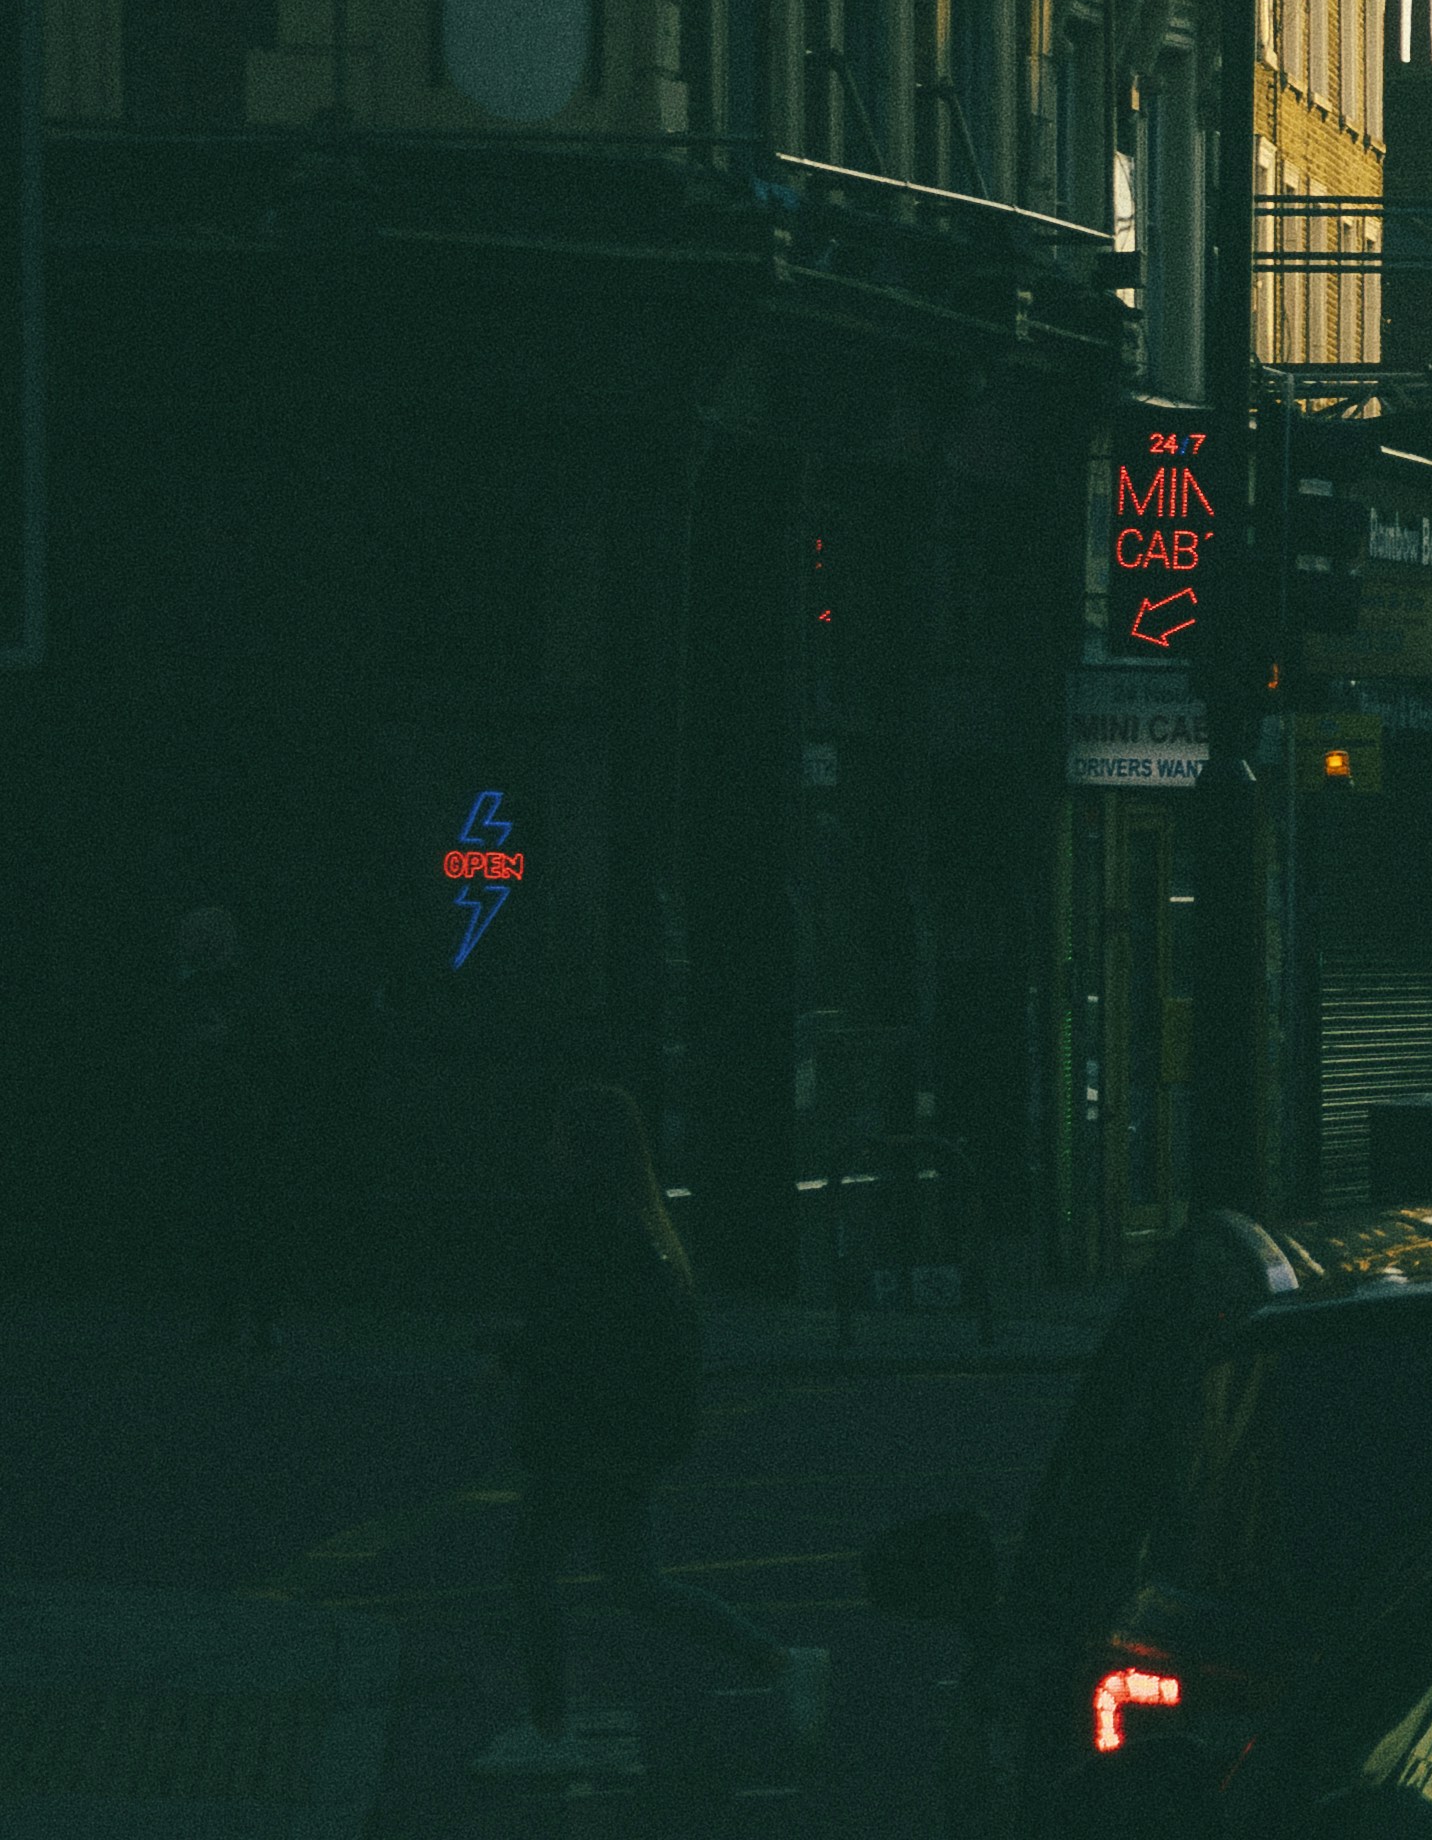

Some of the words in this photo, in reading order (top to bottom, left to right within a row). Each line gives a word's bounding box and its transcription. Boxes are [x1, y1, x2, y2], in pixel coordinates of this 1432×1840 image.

[1149, 432, 1207, 455] 24/7
[1116, 465, 1215, 518] MIN
[1116, 527, 1214, 571] CAB
[1073, 714, 1139, 744] MINI
[1075, 757, 1152, 778] DRIVERS
[443, 850, 524, 880] OPEN
